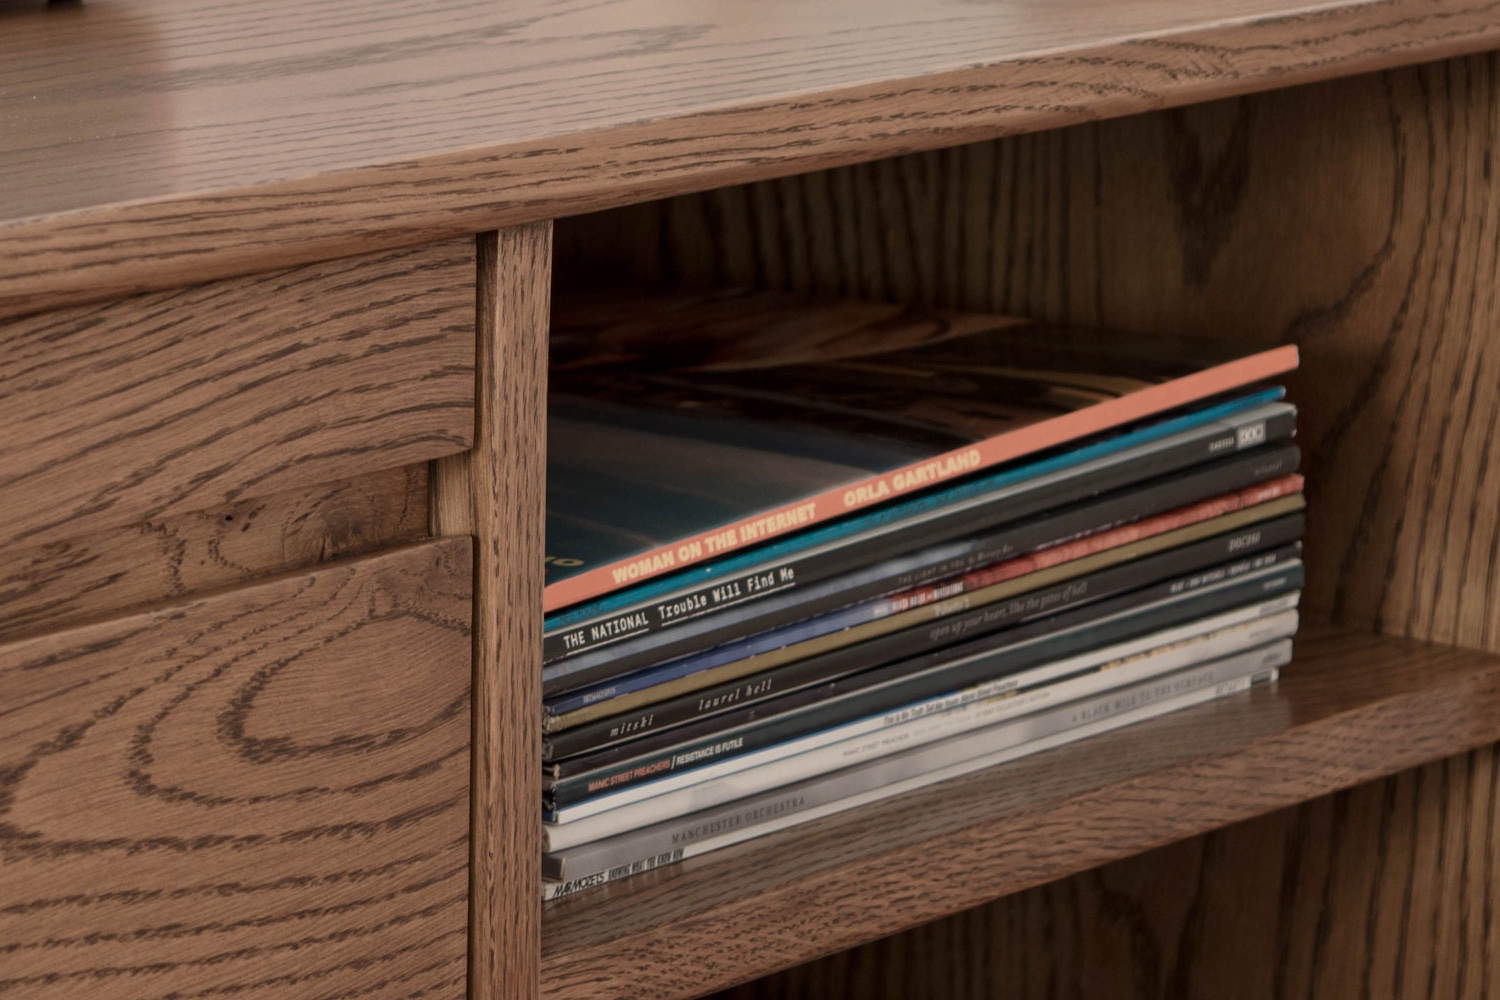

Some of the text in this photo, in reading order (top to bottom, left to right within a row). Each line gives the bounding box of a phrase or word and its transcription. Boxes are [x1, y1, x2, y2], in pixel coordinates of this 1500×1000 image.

[843, 479, 891, 508] ORLA
[893, 449, 981, 491] GARTLAND
[612, 503, 817, 585] WOMAN ON THE INTERNET
[658, 567, 795, 620] Trouble Will Find Me
[563, 630, 587, 650] THE
[591, 611, 650, 641] NATIONAL
[698, 678, 773, 712] laurel hell
[609, 713, 654, 738] mitski
[588, 775, 611, 793] MANIC
[610, 767, 635, 787] STREET
[633, 758, 671, 780] PREACHERS
[677, 745, 714, 767] RESISTANCE
[714, 744, 723, 756] IS
[721, 737, 744, 753] FUTILE
[670, 796, 805, 845] MANCHESTER ORCHESTRA
[552, 871, 606, 899] MARMOZETS
